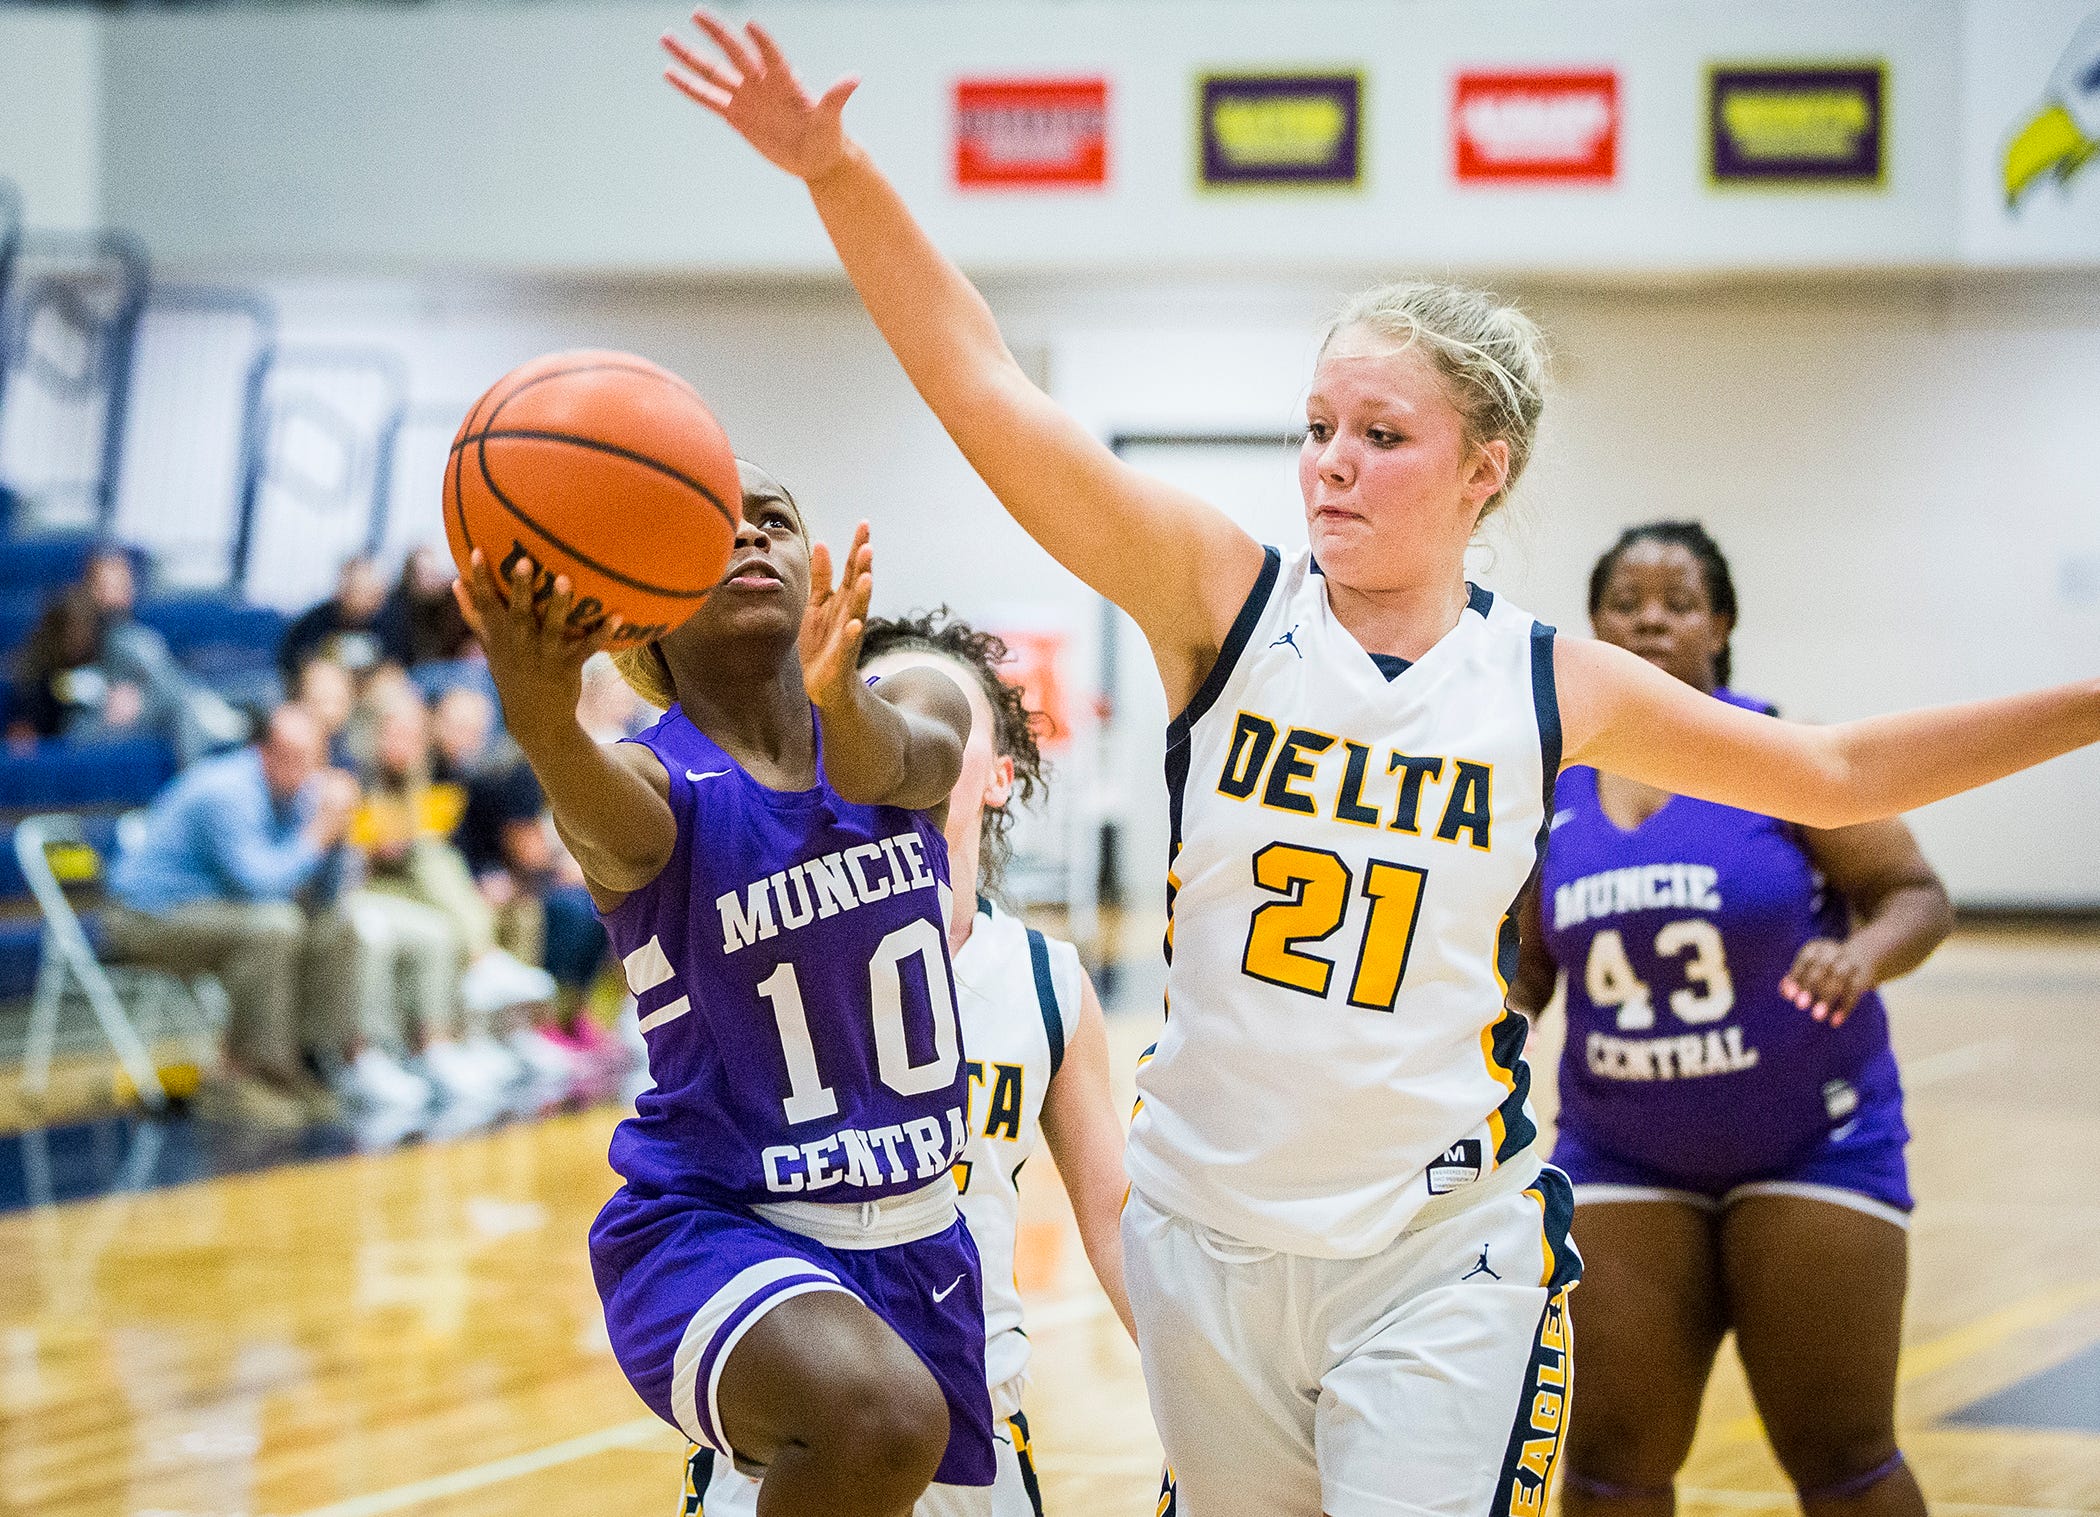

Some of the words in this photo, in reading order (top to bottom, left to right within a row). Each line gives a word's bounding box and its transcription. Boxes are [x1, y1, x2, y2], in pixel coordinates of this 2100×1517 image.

[1215, 709, 1494, 852] DELTA
[716, 832, 936, 955] MUNCIE
[1241, 840, 1429, 1013] 21
[1554, 863, 1722, 931] MUNCIE
[757, 917, 960, 1125] 10
[1585, 918, 1735, 1031] 43
[1585, 1026, 1760, 1082] CENTRAL
[762, 1106, 970, 1193] CENTRA
[1443, 1145, 1466, 1163] M
[1508, 1290, 1567, 1517] EAGLE
